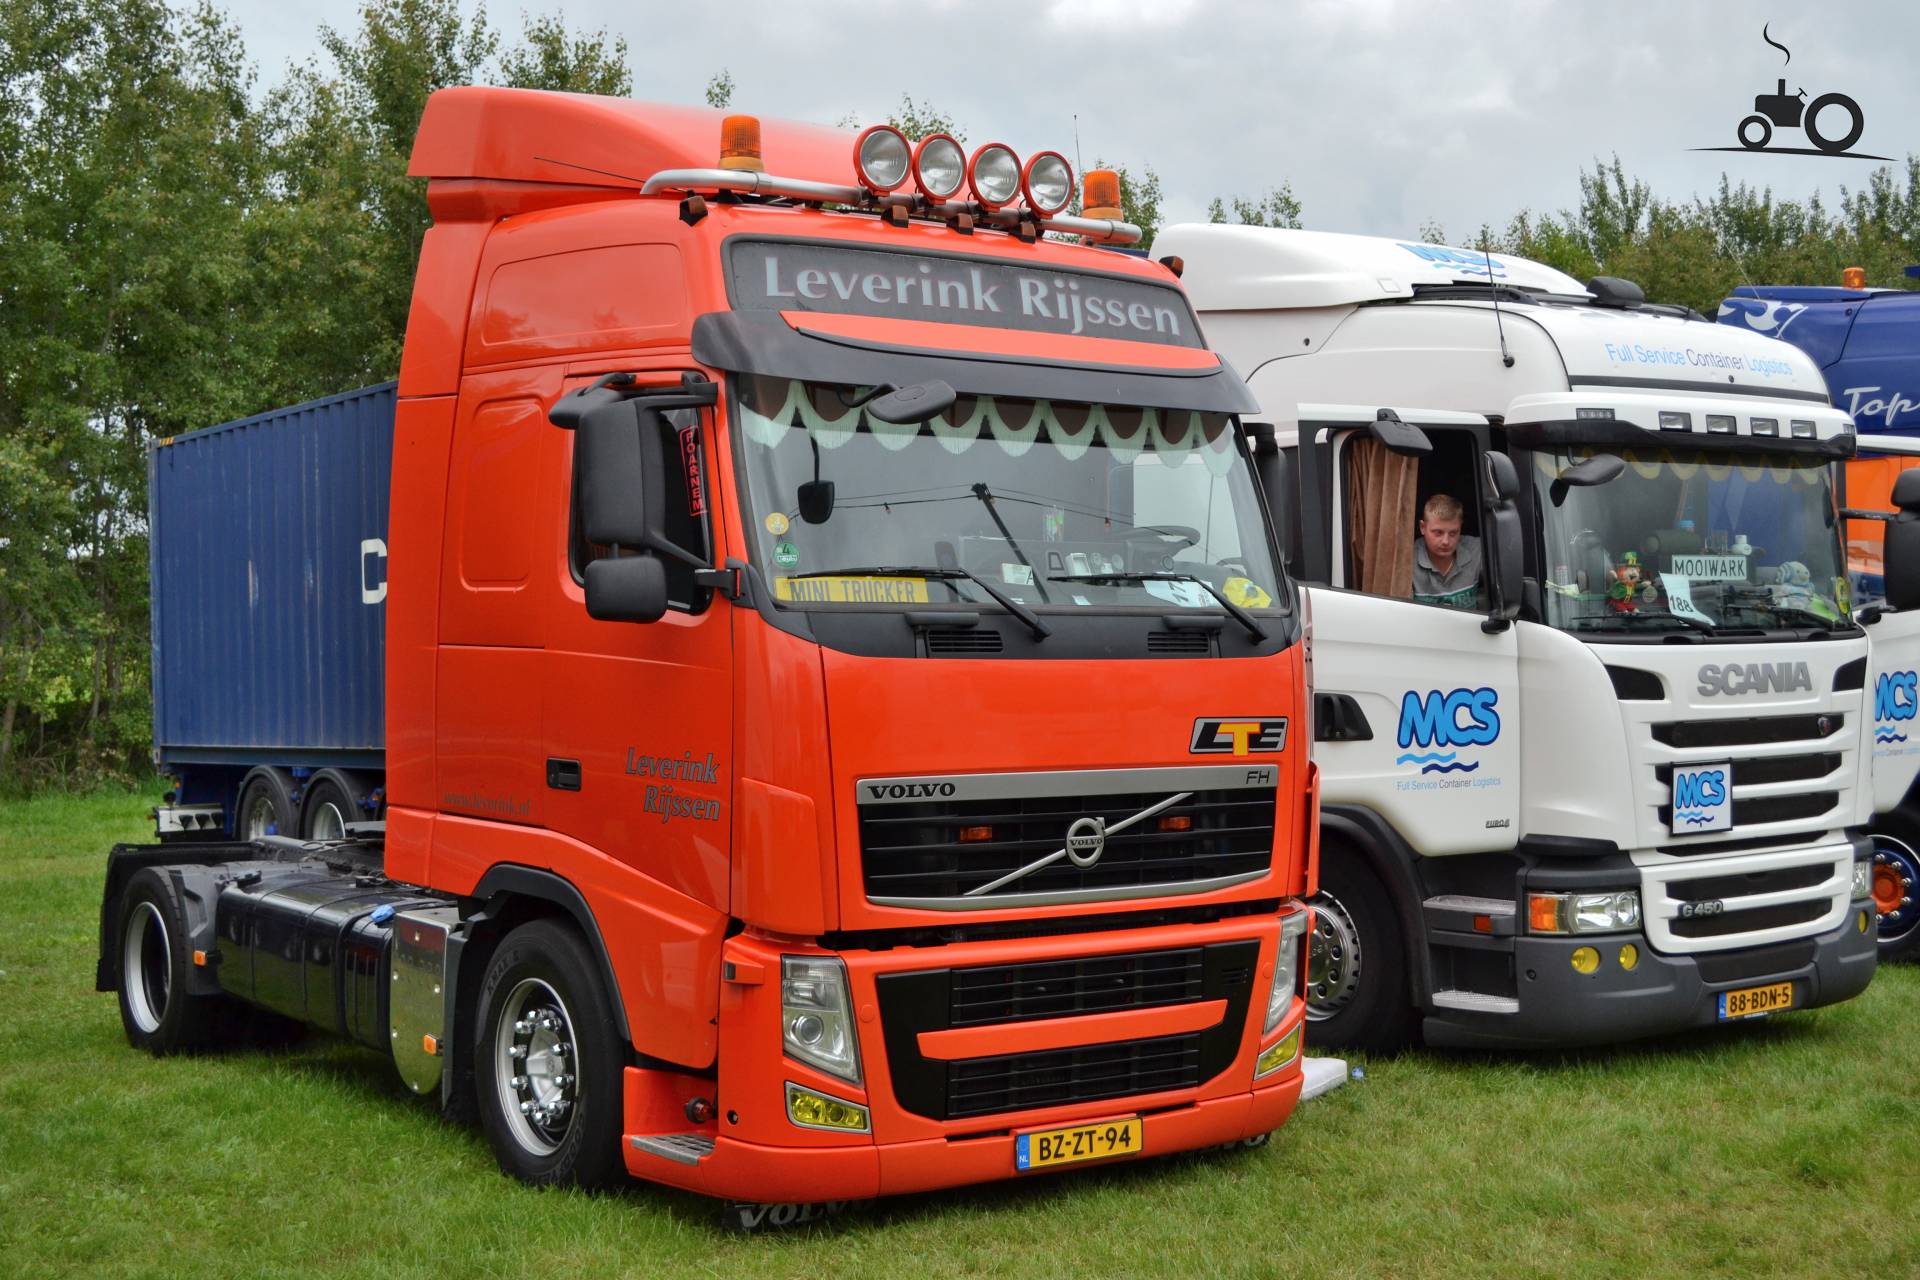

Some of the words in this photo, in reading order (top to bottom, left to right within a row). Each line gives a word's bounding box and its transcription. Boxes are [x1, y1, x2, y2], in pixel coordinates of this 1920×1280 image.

[764, 256, 1002, 313] Leverink
[1019, 276, 1181, 335] Rijssen
[1605, 343, 1633, 363] Full
[1634, 345, 1686, 366] Service
[1686, 348, 1745, 370] Container
[1746, 354, 1793, 376] Logistics
[1674, 558, 1745, 577] MOOIWARK
[789, 579, 830, 602] MINI
[841, 580, 916, 602] TRUCKER
[1670, 595, 1695, 613] 188
[1697, 662, 1812, 697] SCANIA
[1397, 687, 1500, 748] MCS
[1194, 721, 1285, 755] LTE
[625, 747, 720, 784] Leverink
[1246, 770, 1270, 785] FH
[868, 781, 956, 800] VOLVO
[1411, 780, 1438, 791] Service
[1439, 779, 1472, 789] Container
[1675, 770, 1725, 809] MCS
[643, 785, 720, 824] Rijssen
[1069, 836, 1103, 847] VOLVO
[1729, 986, 1790, 1013] 88-BDN-5
[1039, 1125, 1132, 1161] BZ-ZT-94
[1019, 1155, 1028, 1163] NL
